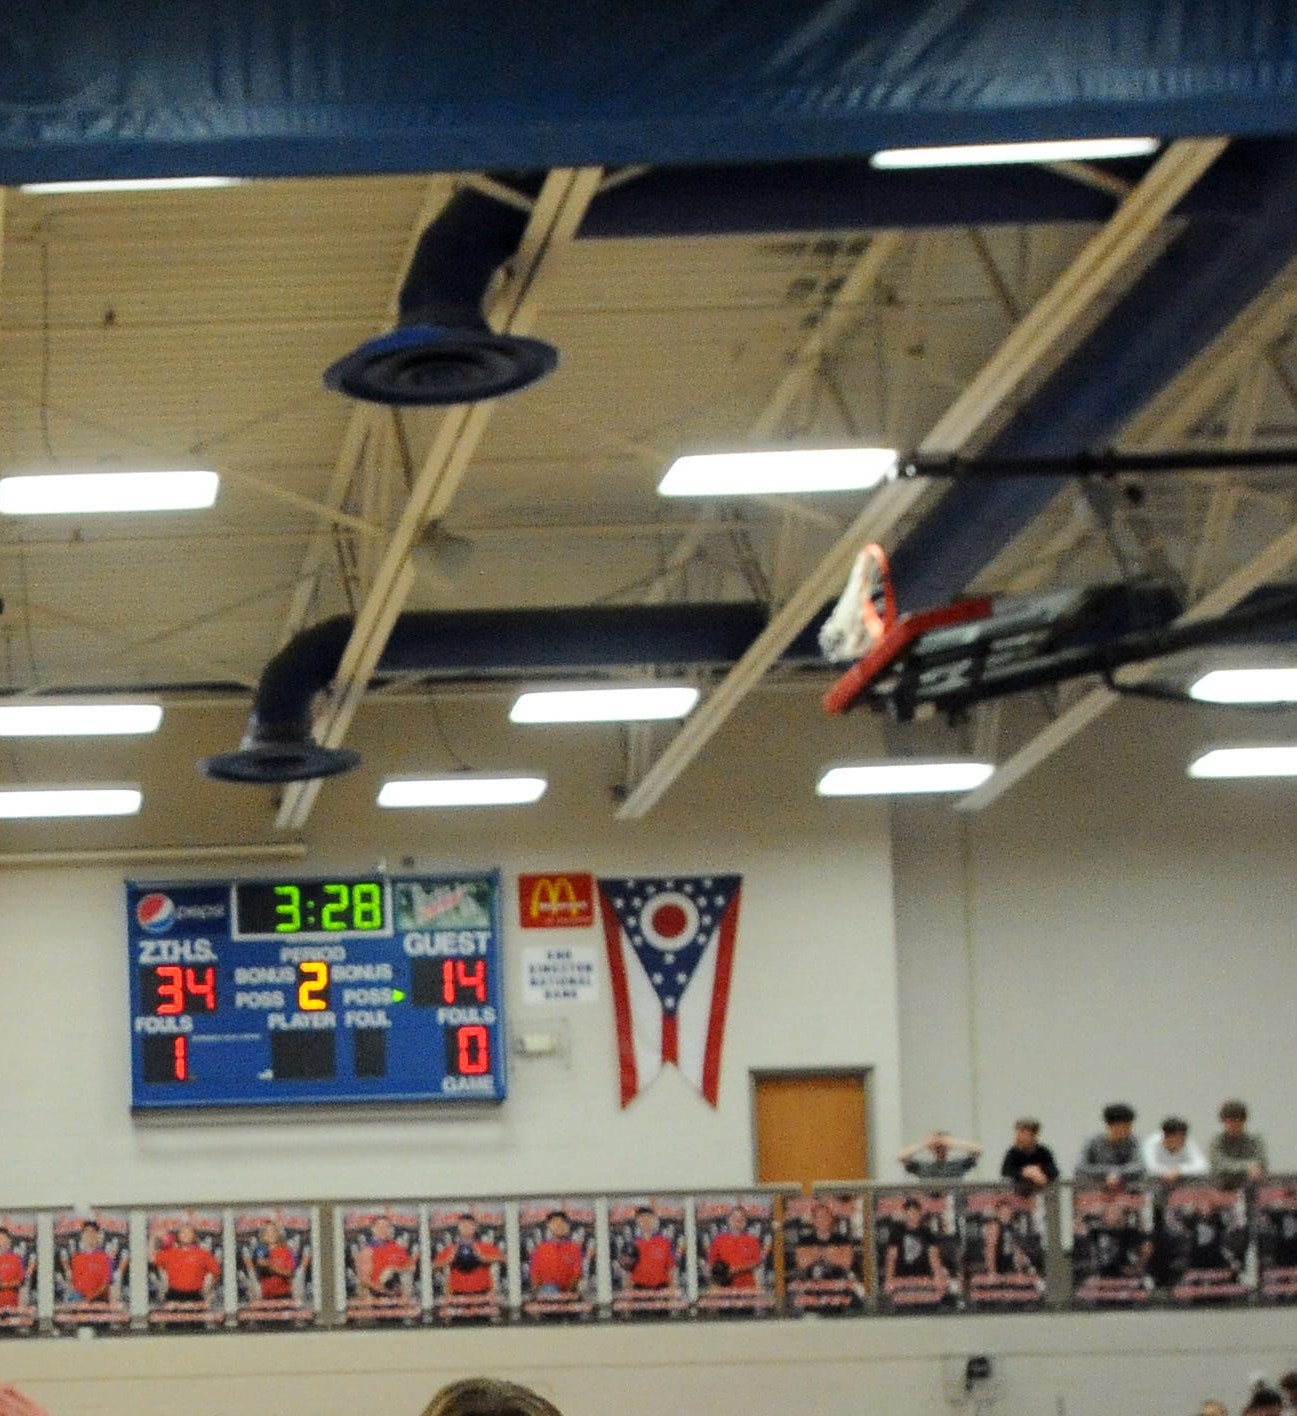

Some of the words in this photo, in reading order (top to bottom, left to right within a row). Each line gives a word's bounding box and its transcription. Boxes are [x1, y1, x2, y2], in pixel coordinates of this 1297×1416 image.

[274, 884, 381, 932] 3:28
[403, 931, 492, 957] GUEST
[234, 967, 296, 985] BONUS
[330, 963, 393, 983] BONUS
[442, 959, 487, 1005] 14
[155, 965, 216, 1015] 34
[298, 961, 329, 1011] 2
[235, 990, 285, 1010] POSS
[135, 1015, 194, 1034] FOULS
[266, 1012, 337, 1031] PLAYER
[344, 1009, 392, 1029] FOUL
[436, 1006, 496, 1026] FOULS
[173, 1036, 188, 1081] 1
[457, 1024, 490, 1076] 0
